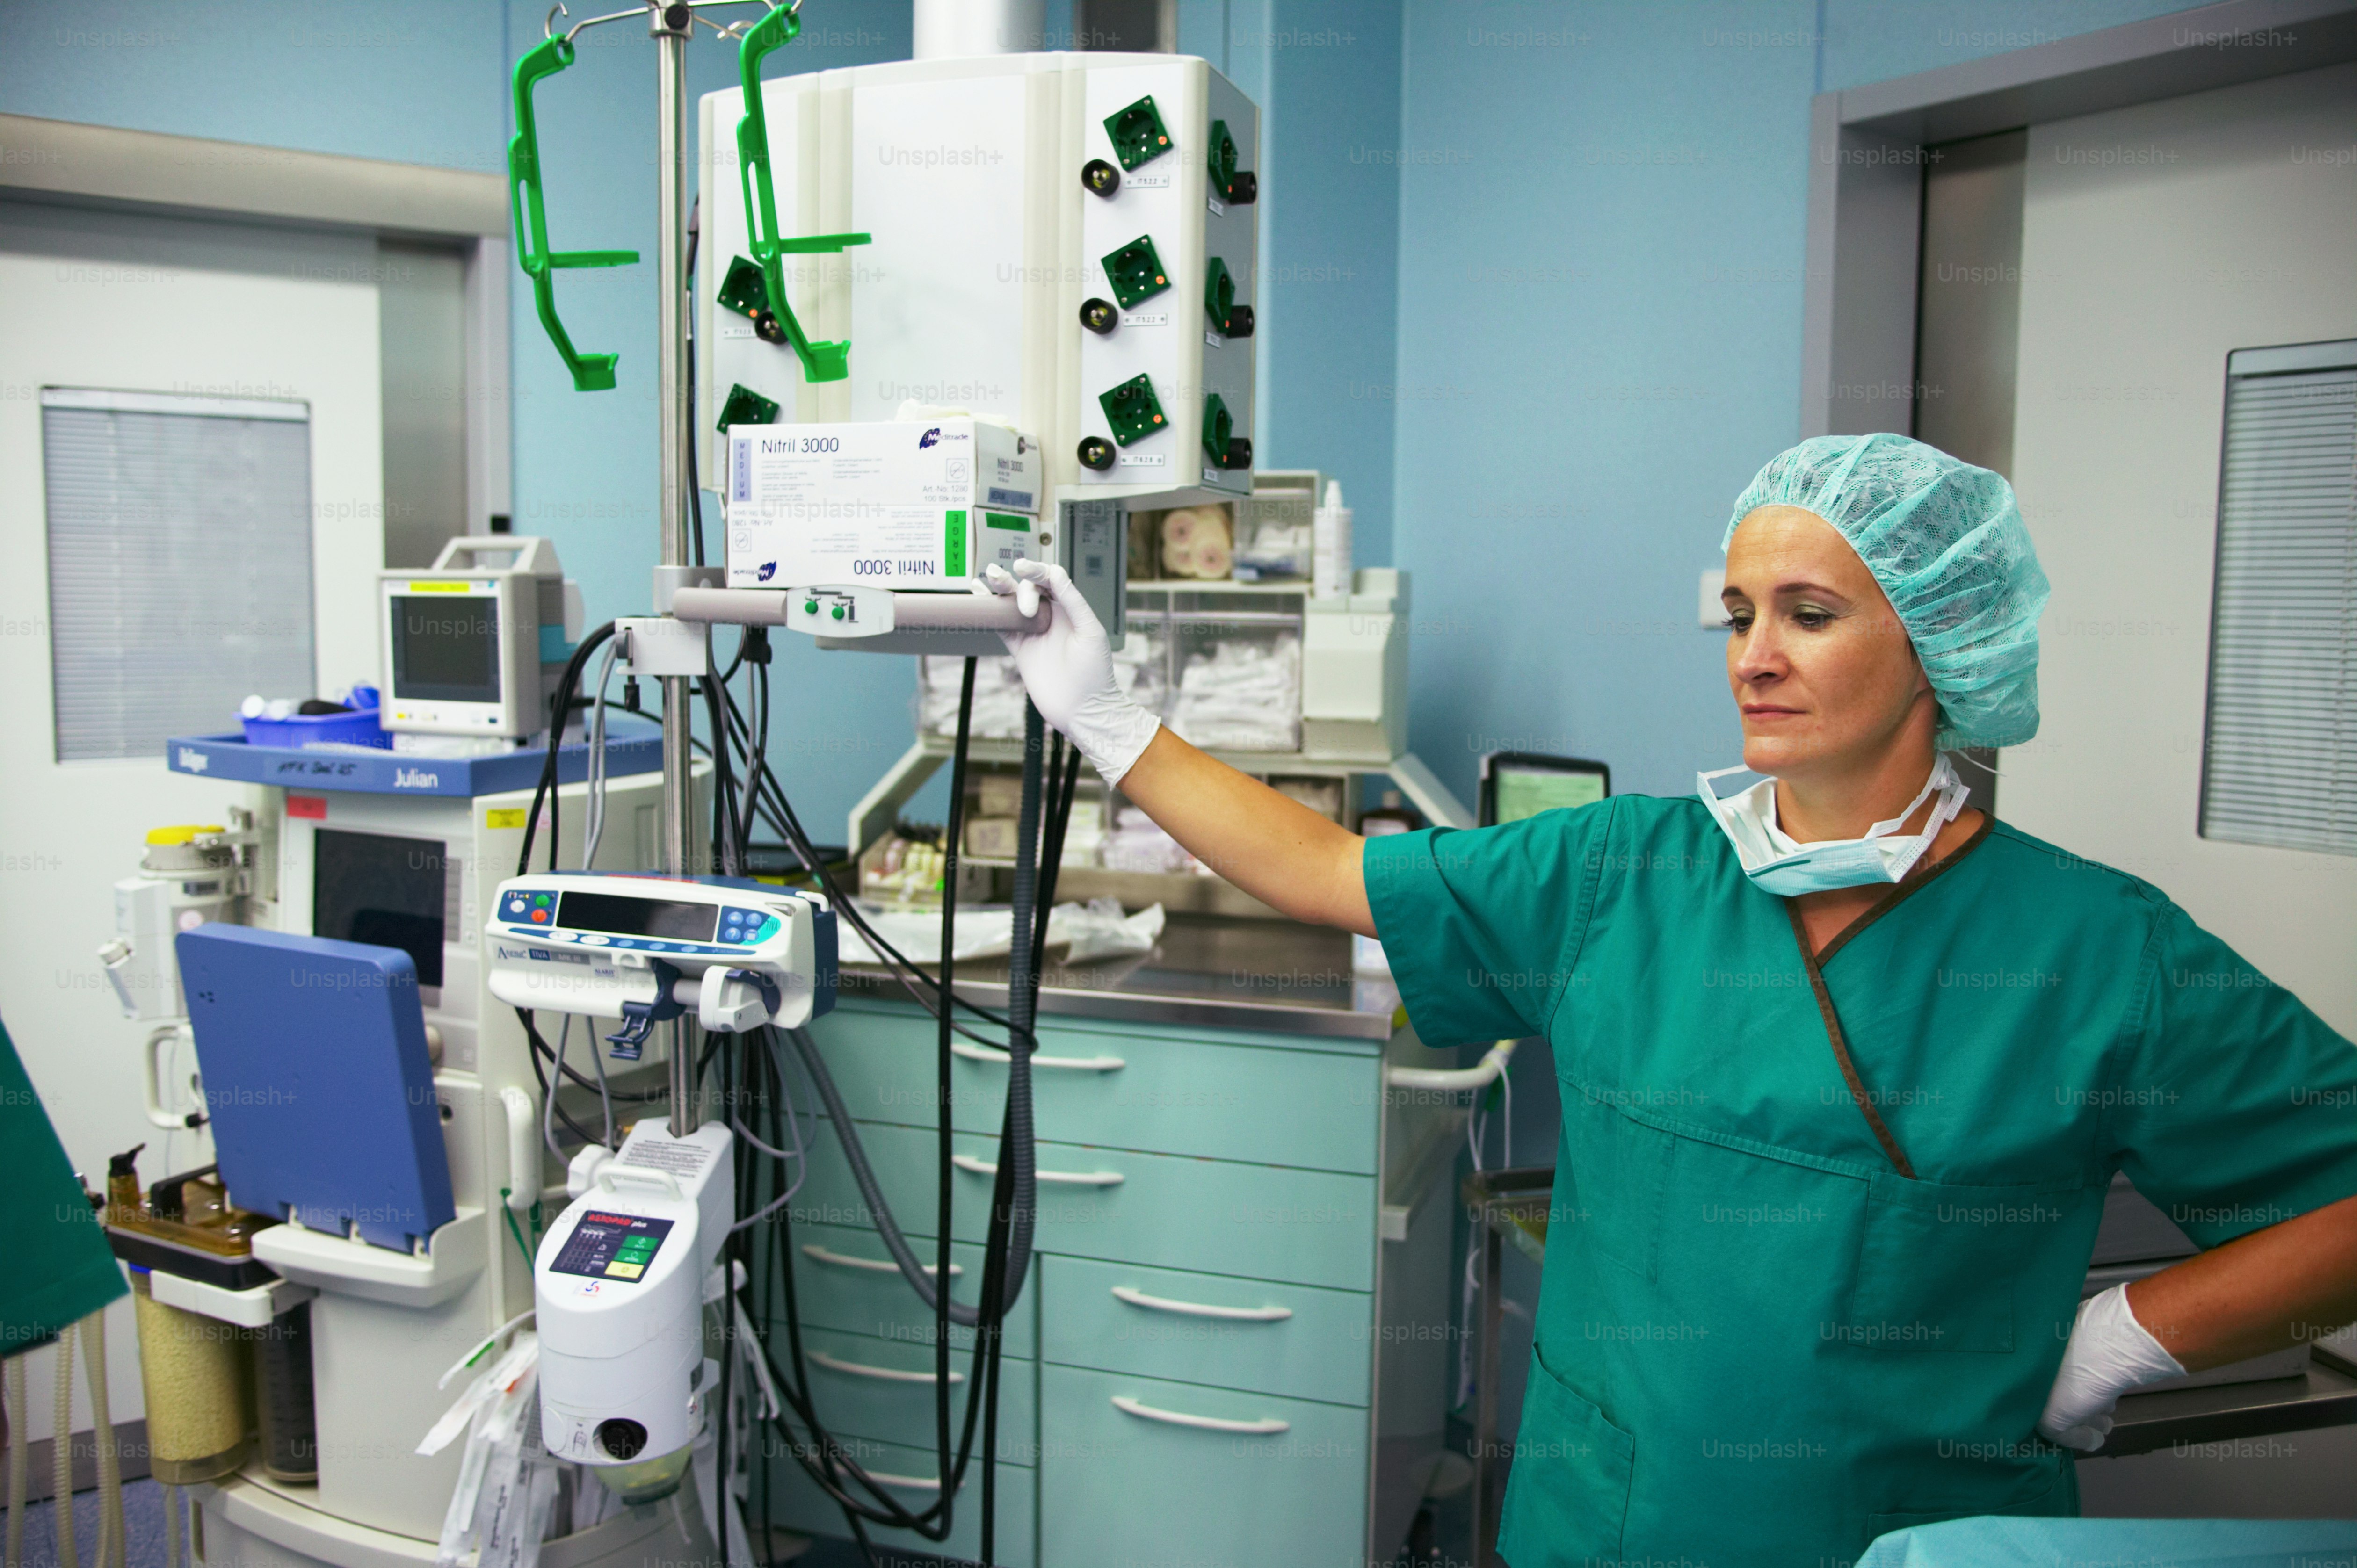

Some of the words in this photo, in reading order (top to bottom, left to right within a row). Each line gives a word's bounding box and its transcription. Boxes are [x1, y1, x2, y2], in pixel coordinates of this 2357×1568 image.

[762, 439, 795, 453] Nitril
[801, 437, 839, 453] 3000
[854, 559, 892, 575] 3000
[898, 560, 934, 575] Nitril
[393, 767, 438, 788] Julian
[767, 920, 778, 932] TIVA
[531, 950, 548, 959] TIVA
